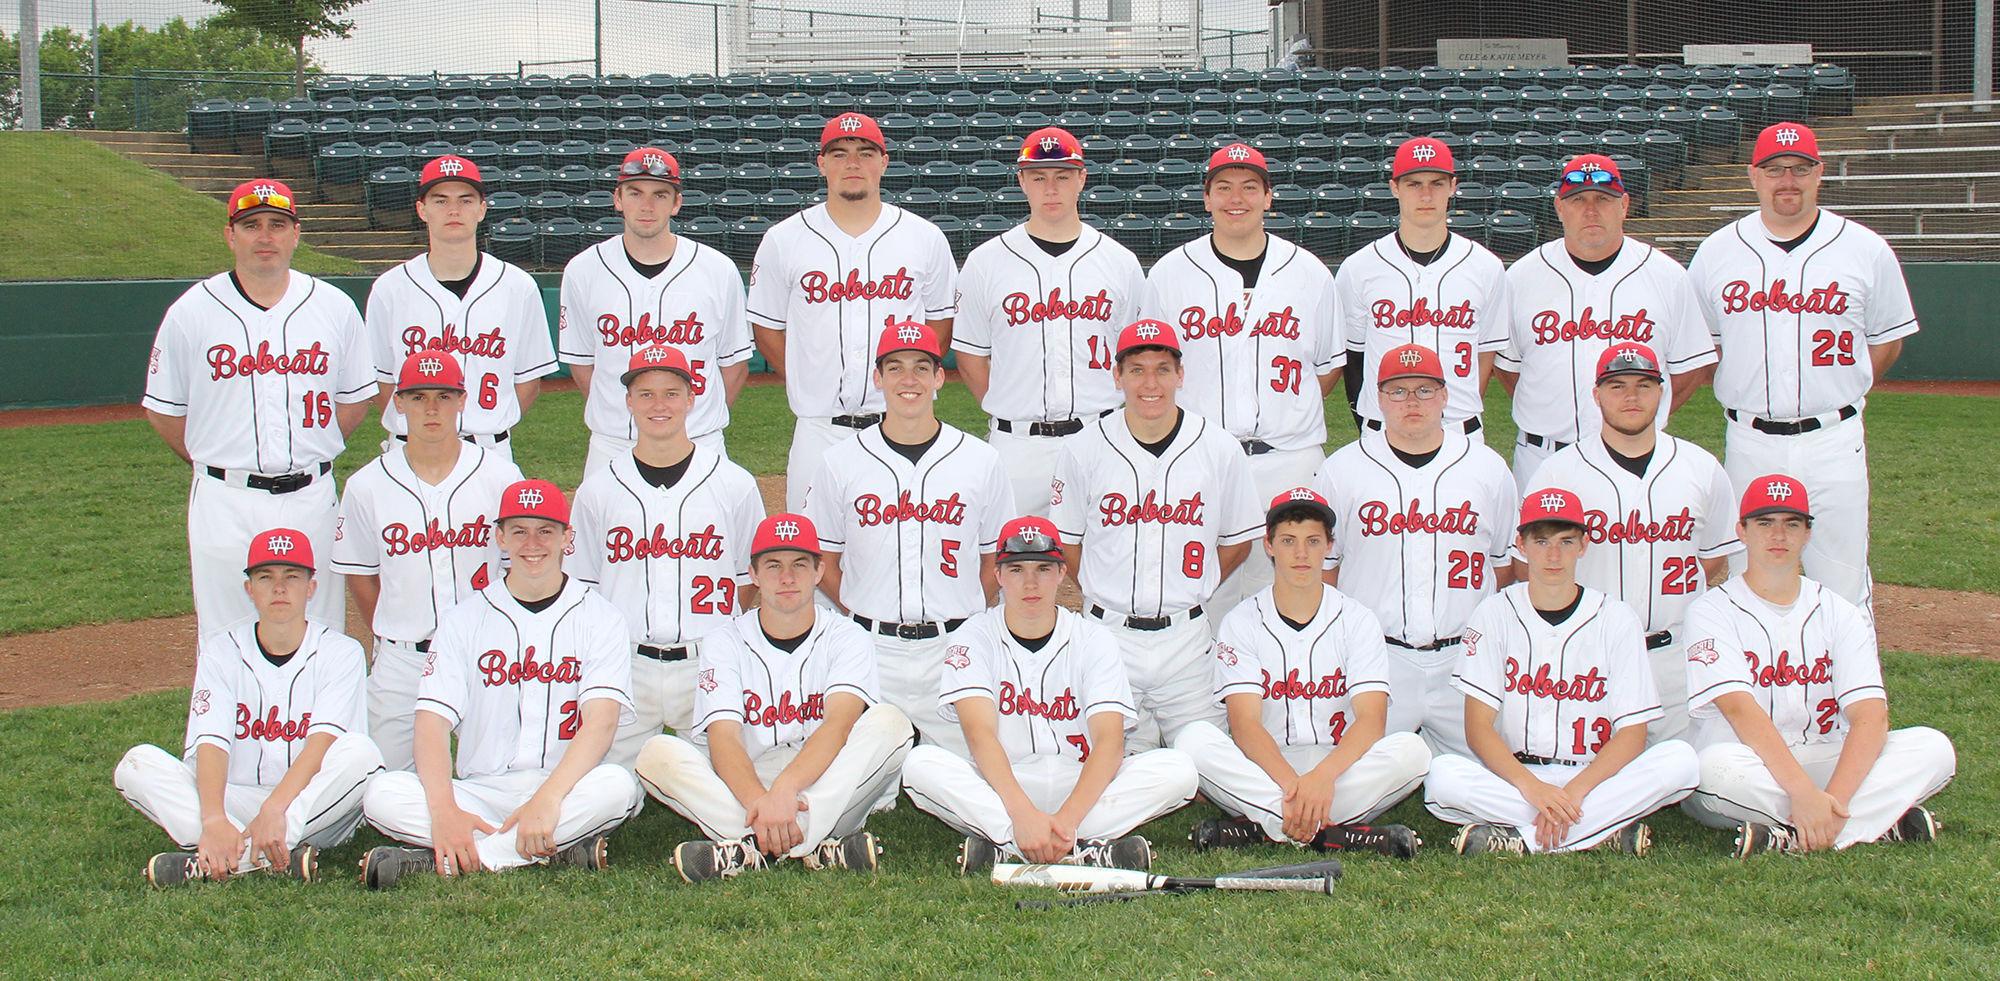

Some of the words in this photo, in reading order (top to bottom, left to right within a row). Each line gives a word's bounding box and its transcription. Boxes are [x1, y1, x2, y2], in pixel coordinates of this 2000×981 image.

[1458, 53, 1481, 61] CELE
[1490, 53, 1516, 61] KATIE
[802, 266, 914, 303] Bobcats
[1722, 278, 1849, 316] Bobcats
[1002, 287, 1112, 326] Bobcats
[1371, 297, 1475, 330] Bobcats
[1531, 306, 1655, 345] Bobcats
[402, 324, 507, 360] Bobcats
[598, 311, 704, 347] Bobcats
[1811, 329, 1856, 367] 29
[207, 340, 330, 381] Bobcats
[690, 359, 706, 396] 5
[1454, 342, 1473, 378] 3
[303, 390, 332, 428] 16
[479, 373, 500, 410] 6
[855, 491, 967, 527] Bobcats
[1099, 489, 1205, 527] Bobcat
[1358, 498, 1479, 536] Bobcats
[1583, 506, 1697, 544] Bobcats
[606, 522, 723, 564] Bobcats
[940, 539, 961, 577] 5
[1183, 541, 1205, 579] 8
[1448, 550, 1485, 589] 28
[1661, 555, 1699, 595] 22
[691, 575, 736, 615] 23
[479, 646, 581, 687] Bobca
[559, 700, 584, 740] 2
[999, 681, 1079, 721] Bobcat
[1815, 698, 1839, 734] 2
[236, 703, 312, 742] Bobca
[1572, 716, 1612, 755] 13
